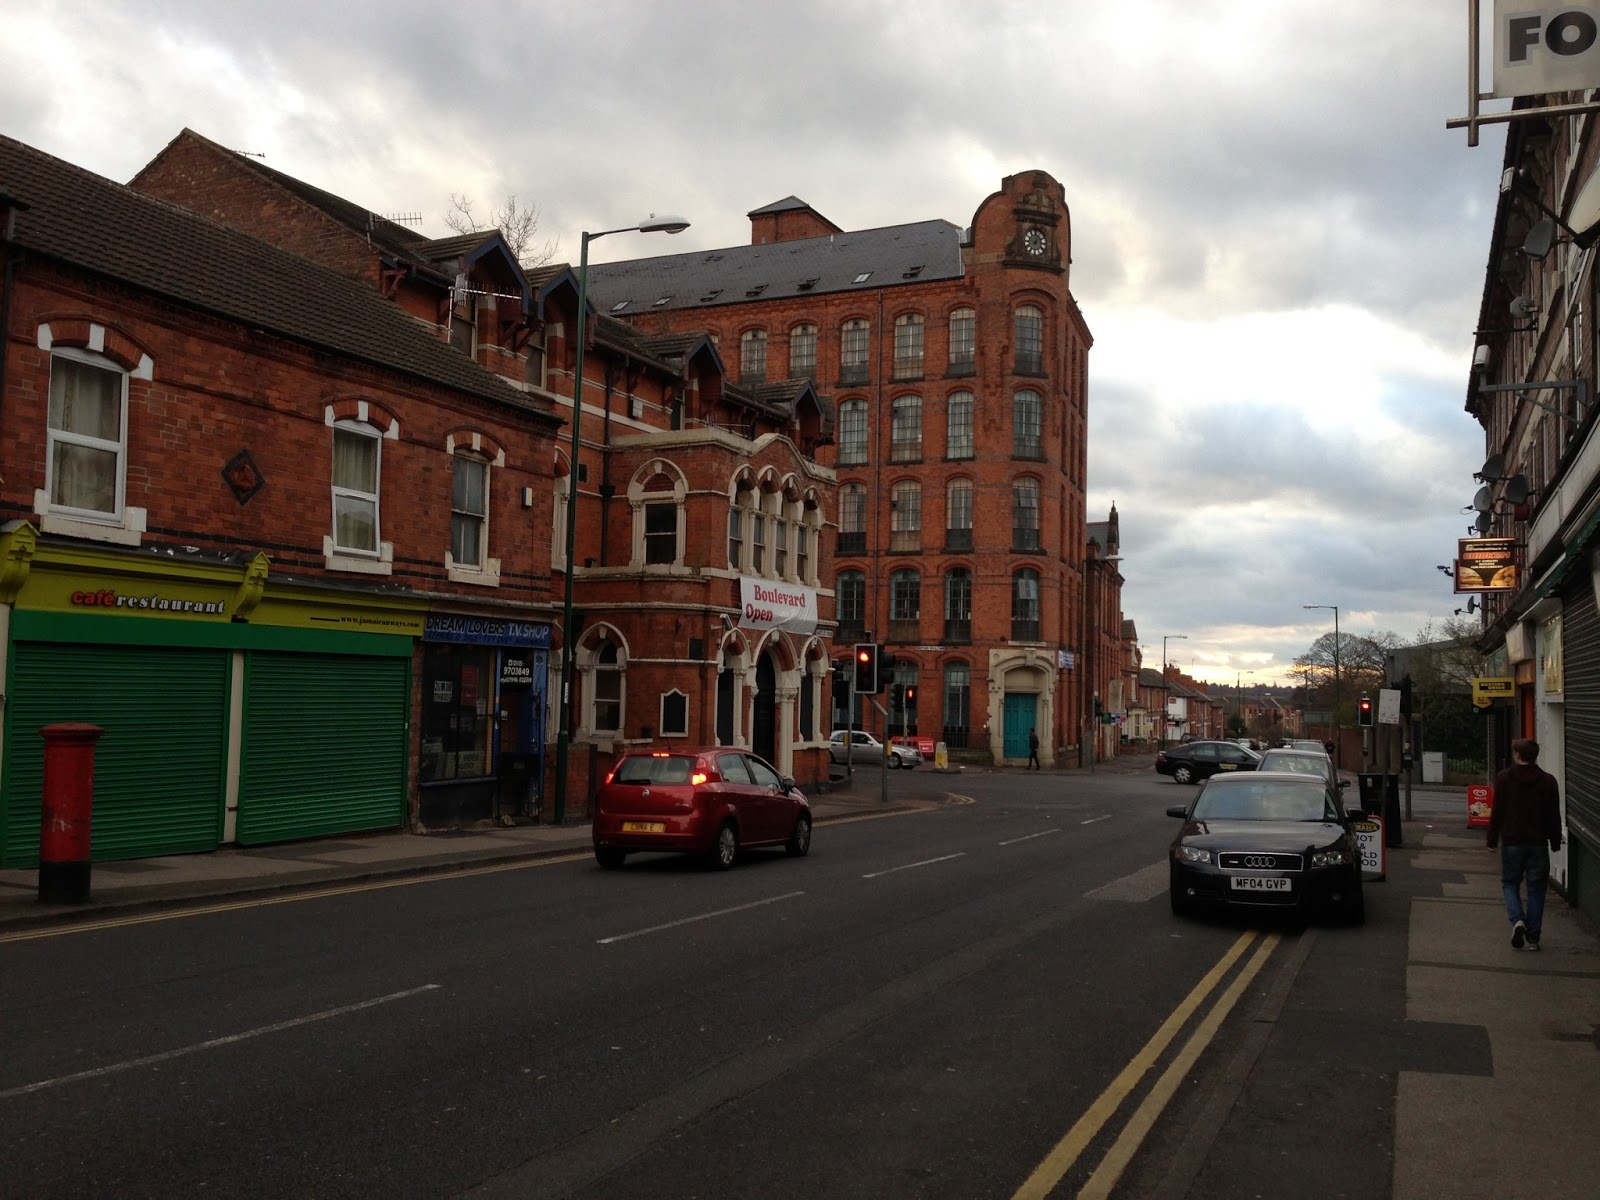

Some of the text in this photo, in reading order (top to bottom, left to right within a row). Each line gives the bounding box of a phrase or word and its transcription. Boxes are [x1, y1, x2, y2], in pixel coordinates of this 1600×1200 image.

[1510, 11, 1597, 62] FO
[72, 590, 225, 614] café restaurant
[754, 585, 806, 607] Boulevard
[746, 603, 773, 623] Open
[426, 614, 465, 634] DREAM
[467, 619, 506, 637] LOVERS
[1236, 878, 1287, 889] MF04 GVP
